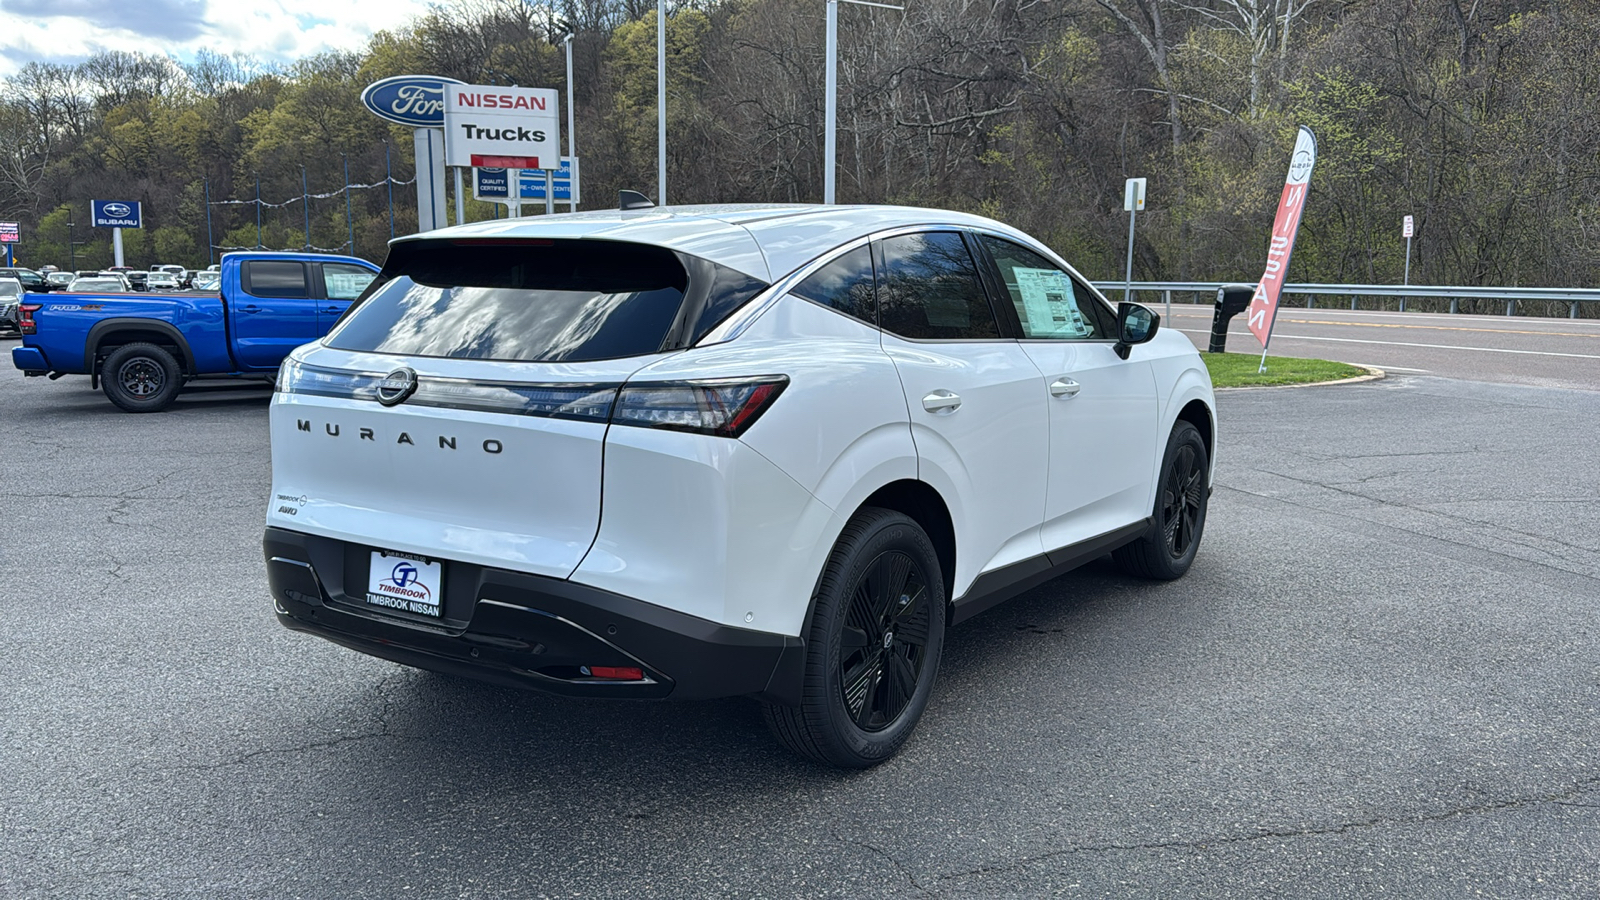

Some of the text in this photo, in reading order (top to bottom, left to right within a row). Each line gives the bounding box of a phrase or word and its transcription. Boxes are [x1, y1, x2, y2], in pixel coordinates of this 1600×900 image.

[458, 92, 546, 111] NISSAN
[460, 123, 546, 143] Trucks
[97, 218, 138, 226] SUBARU
[297, 419, 503, 454] MURANO
[278, 505, 298, 516] AWD
[379, 583, 427, 600] TIMBROOK
[366, 593, 440, 617] TIMBROOK NISSAN
